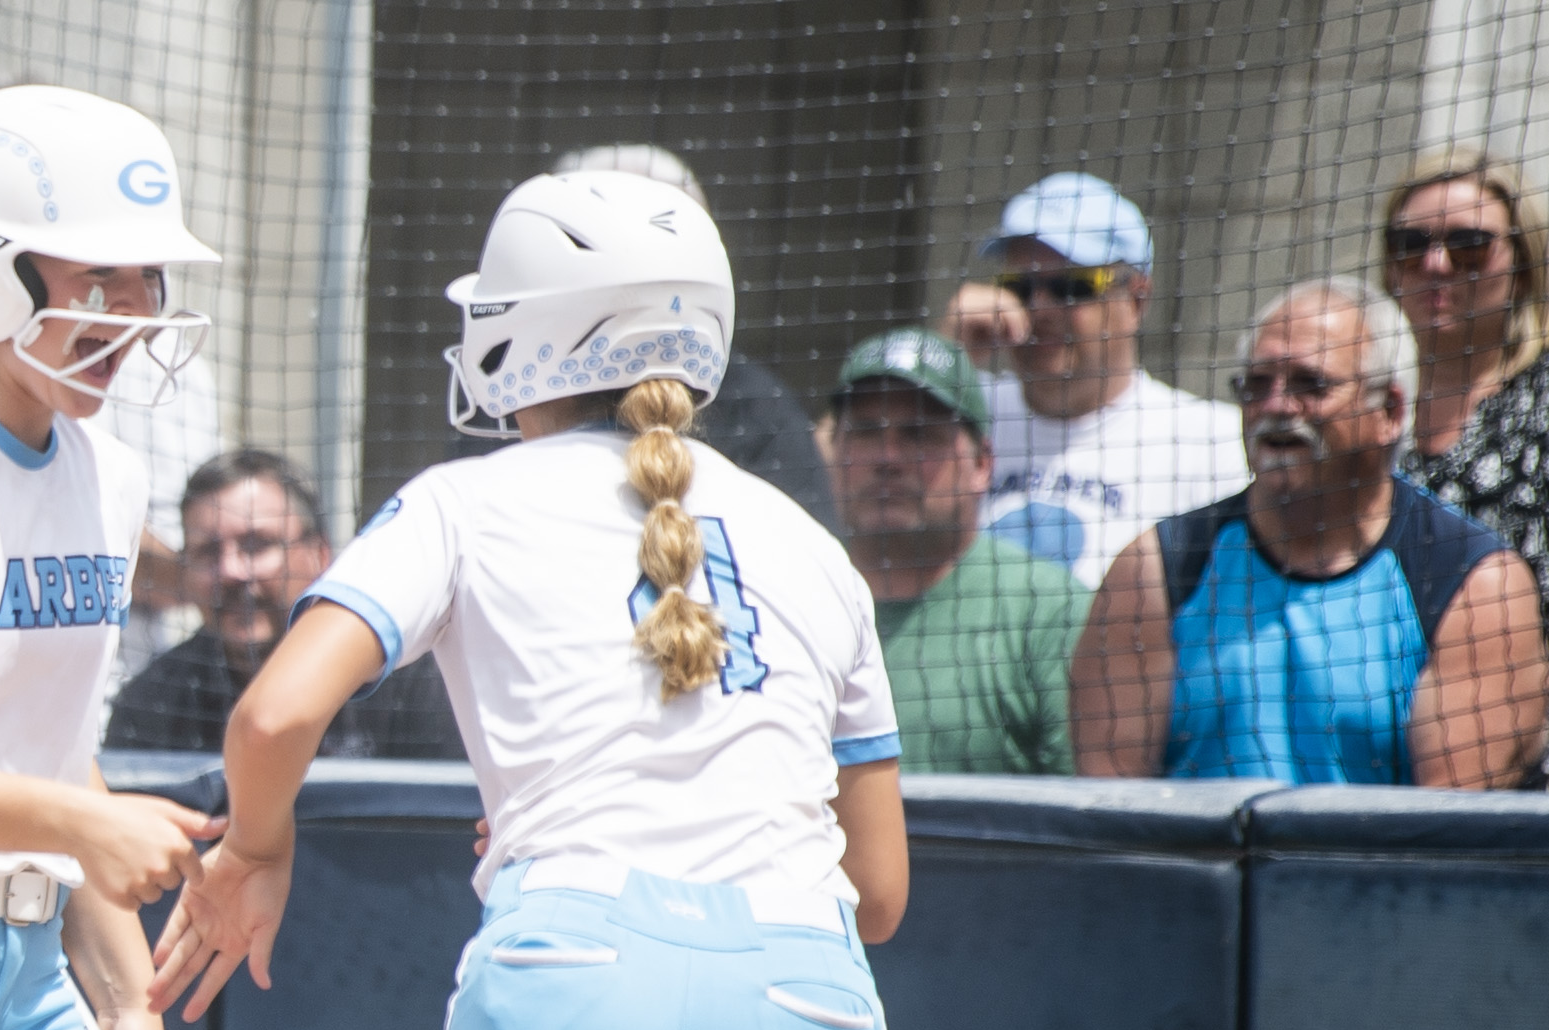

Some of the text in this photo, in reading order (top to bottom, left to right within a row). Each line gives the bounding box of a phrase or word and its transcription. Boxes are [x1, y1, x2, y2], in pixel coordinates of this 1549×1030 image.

[118, 160, 170, 206] G
[472, 304, 506, 314] EASTON
[669, 295, 680, 313] 4
